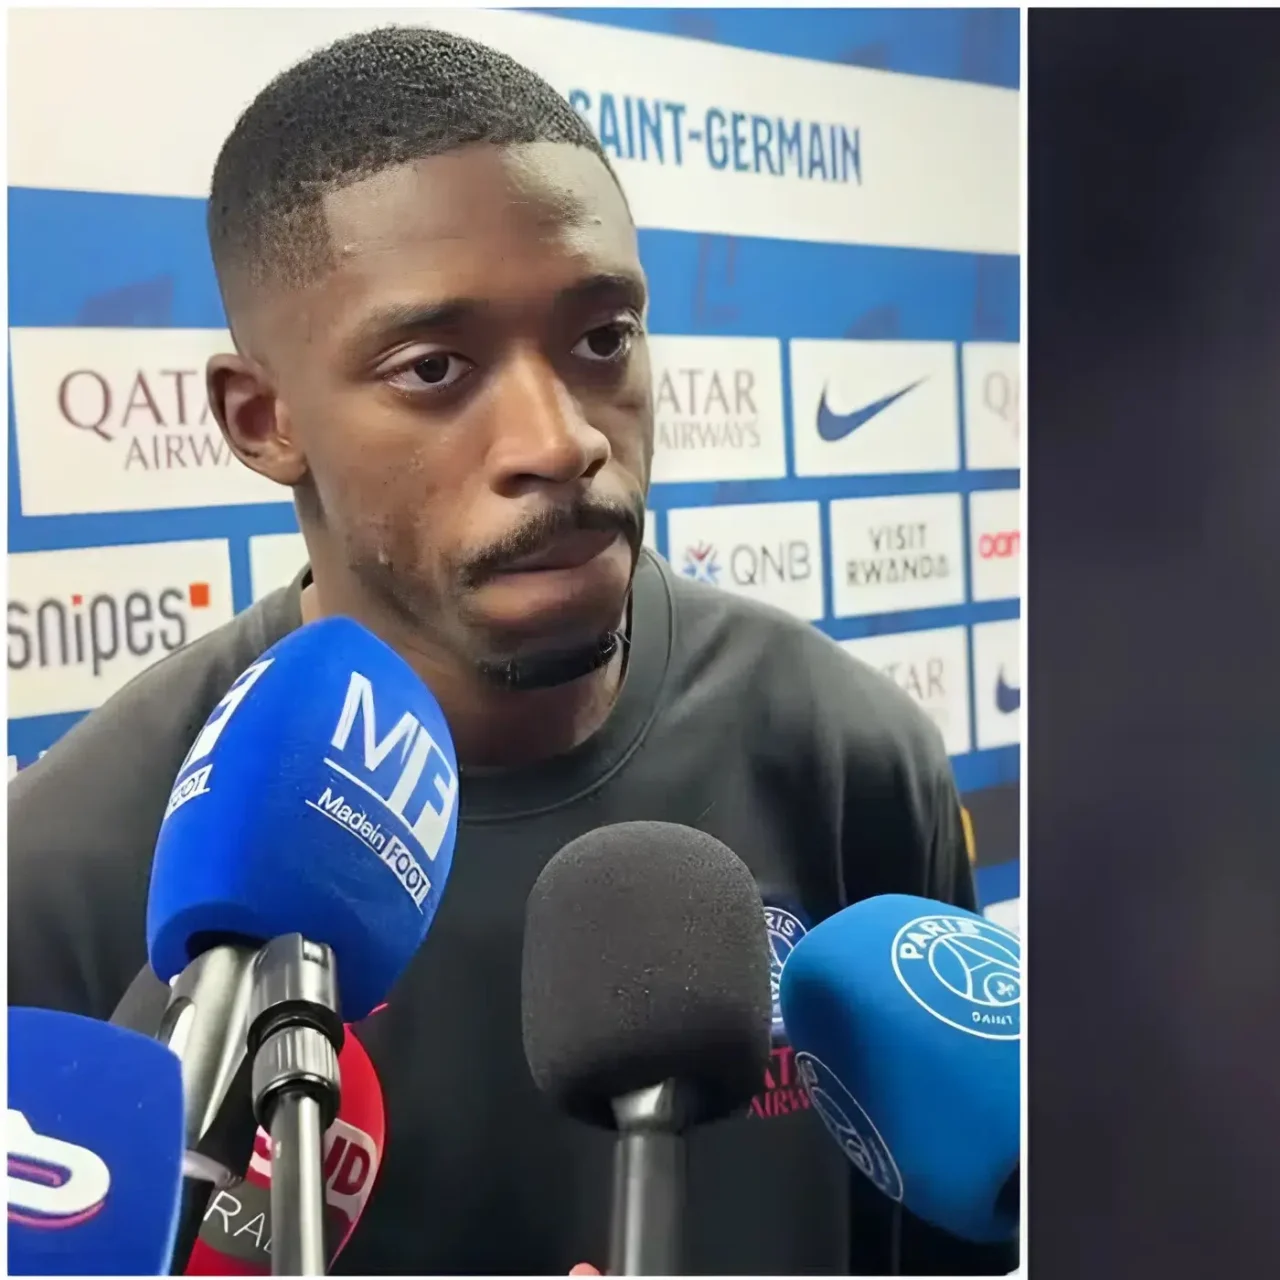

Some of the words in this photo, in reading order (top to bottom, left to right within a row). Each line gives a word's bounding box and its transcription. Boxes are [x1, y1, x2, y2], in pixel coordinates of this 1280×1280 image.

[57, 368, 210, 443] QAT
[124, 433, 236, 472] AIRW
[867, 523, 927, 552] VISIT
[730, 541, 812, 586] QNB
[846, 555, 949, 588] RWANDA
[8, 587, 187, 677] snipes
